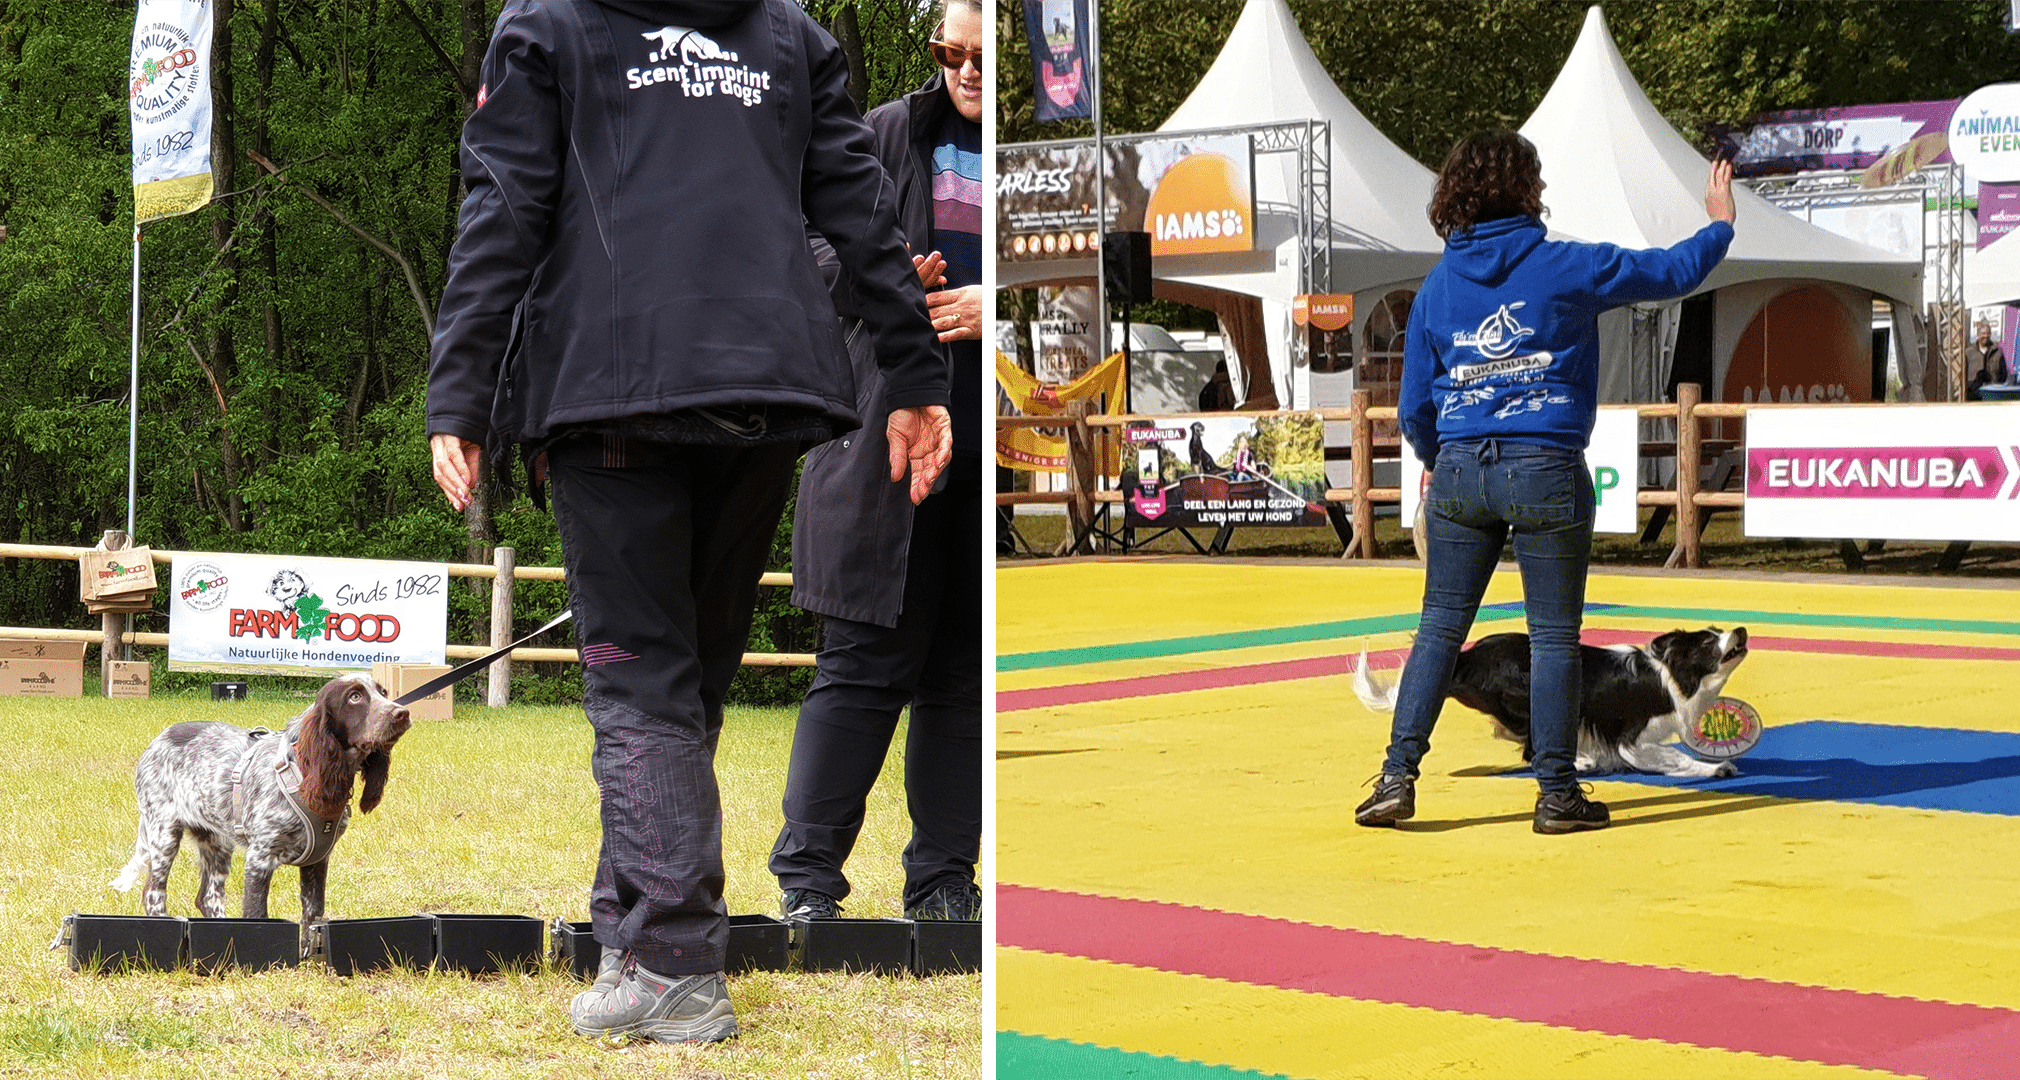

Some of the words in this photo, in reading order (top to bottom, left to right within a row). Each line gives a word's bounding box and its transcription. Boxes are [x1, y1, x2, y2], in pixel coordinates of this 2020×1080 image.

[152, 22, 190, 44] natuurlijk
[157, 49, 197, 77] FOOD
[626, 64, 689, 90] Scent
[693, 62, 771, 91] imprint
[136, 69, 186, 111] QUALITY
[146, 95, 190, 125] kunstmatige
[187, 64, 200, 93] stoffen
[681, 77, 715, 97] for
[720, 80, 762, 107] dogs
[156, 131, 195, 158] 1982
[1804, 128, 1845, 149] DORP
[1155, 210, 1223, 241] IAMS
[1463, 357, 1542, 378] EUKANUBA
[1131, 430, 1181, 441] EUKANUBA
[1767, 458, 1985, 489] EUKANUBA
[1184, 500, 1206, 510] DEEL
[1207, 500, 1226, 510] EEN
[1227, 499, 1252, 510] LANG
[1253, 499, 1267, 509] EN
[1268, 498, 1306, 509] GEZOND
[1198, 512, 1227, 522] LEVEN
[1228, 512, 1248, 522] MET
[1249, 511, 1265, 522] UW
[1266, 511, 1293, 521] HOND
[206, 576, 229, 590] FOOD
[336, 580, 388, 606] Sinds
[395, 574, 441, 600] 1982
[229, 608, 299, 639] FARM
[324, 612, 401, 643] FOOD
[228, 646, 299, 662] Natuurlijke
[302, 649, 401, 663] Hondenvoeding
